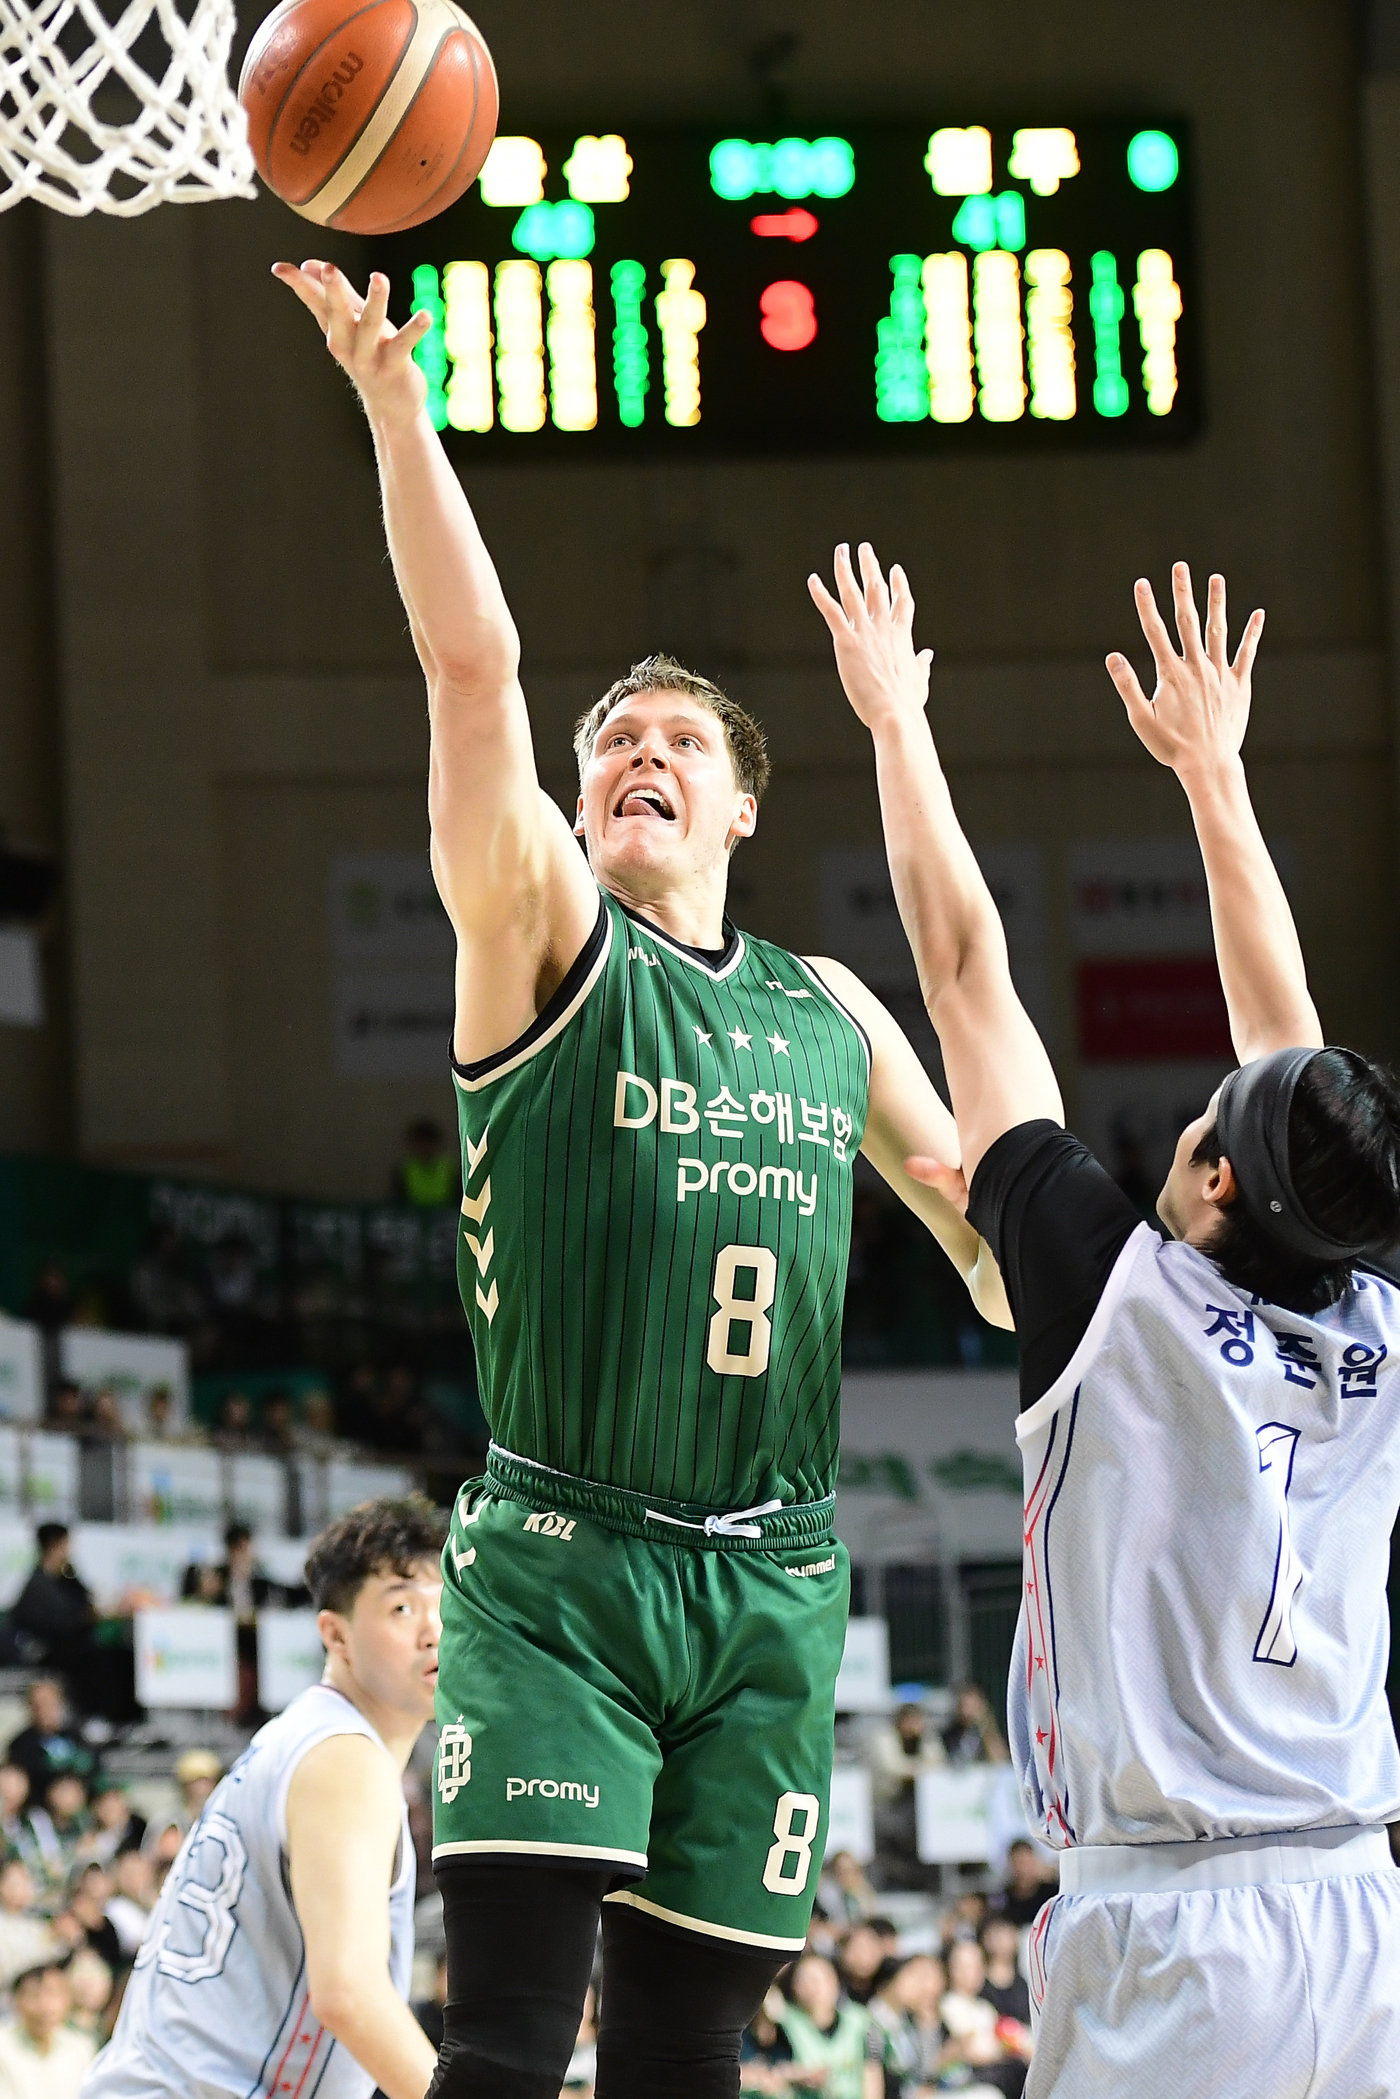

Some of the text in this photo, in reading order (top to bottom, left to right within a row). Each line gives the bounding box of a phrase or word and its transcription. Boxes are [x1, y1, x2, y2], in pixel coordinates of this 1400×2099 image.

[289, 51, 364, 156] molten
[613, 1071, 853, 1162] DB손해보험
[676, 1157, 818, 1216] promy
[705, 1243, 778, 1379] 8
[522, 1510, 577, 1542] KBL
[506, 1777, 600, 1808] promy
[761, 1790, 820, 1897] 8
